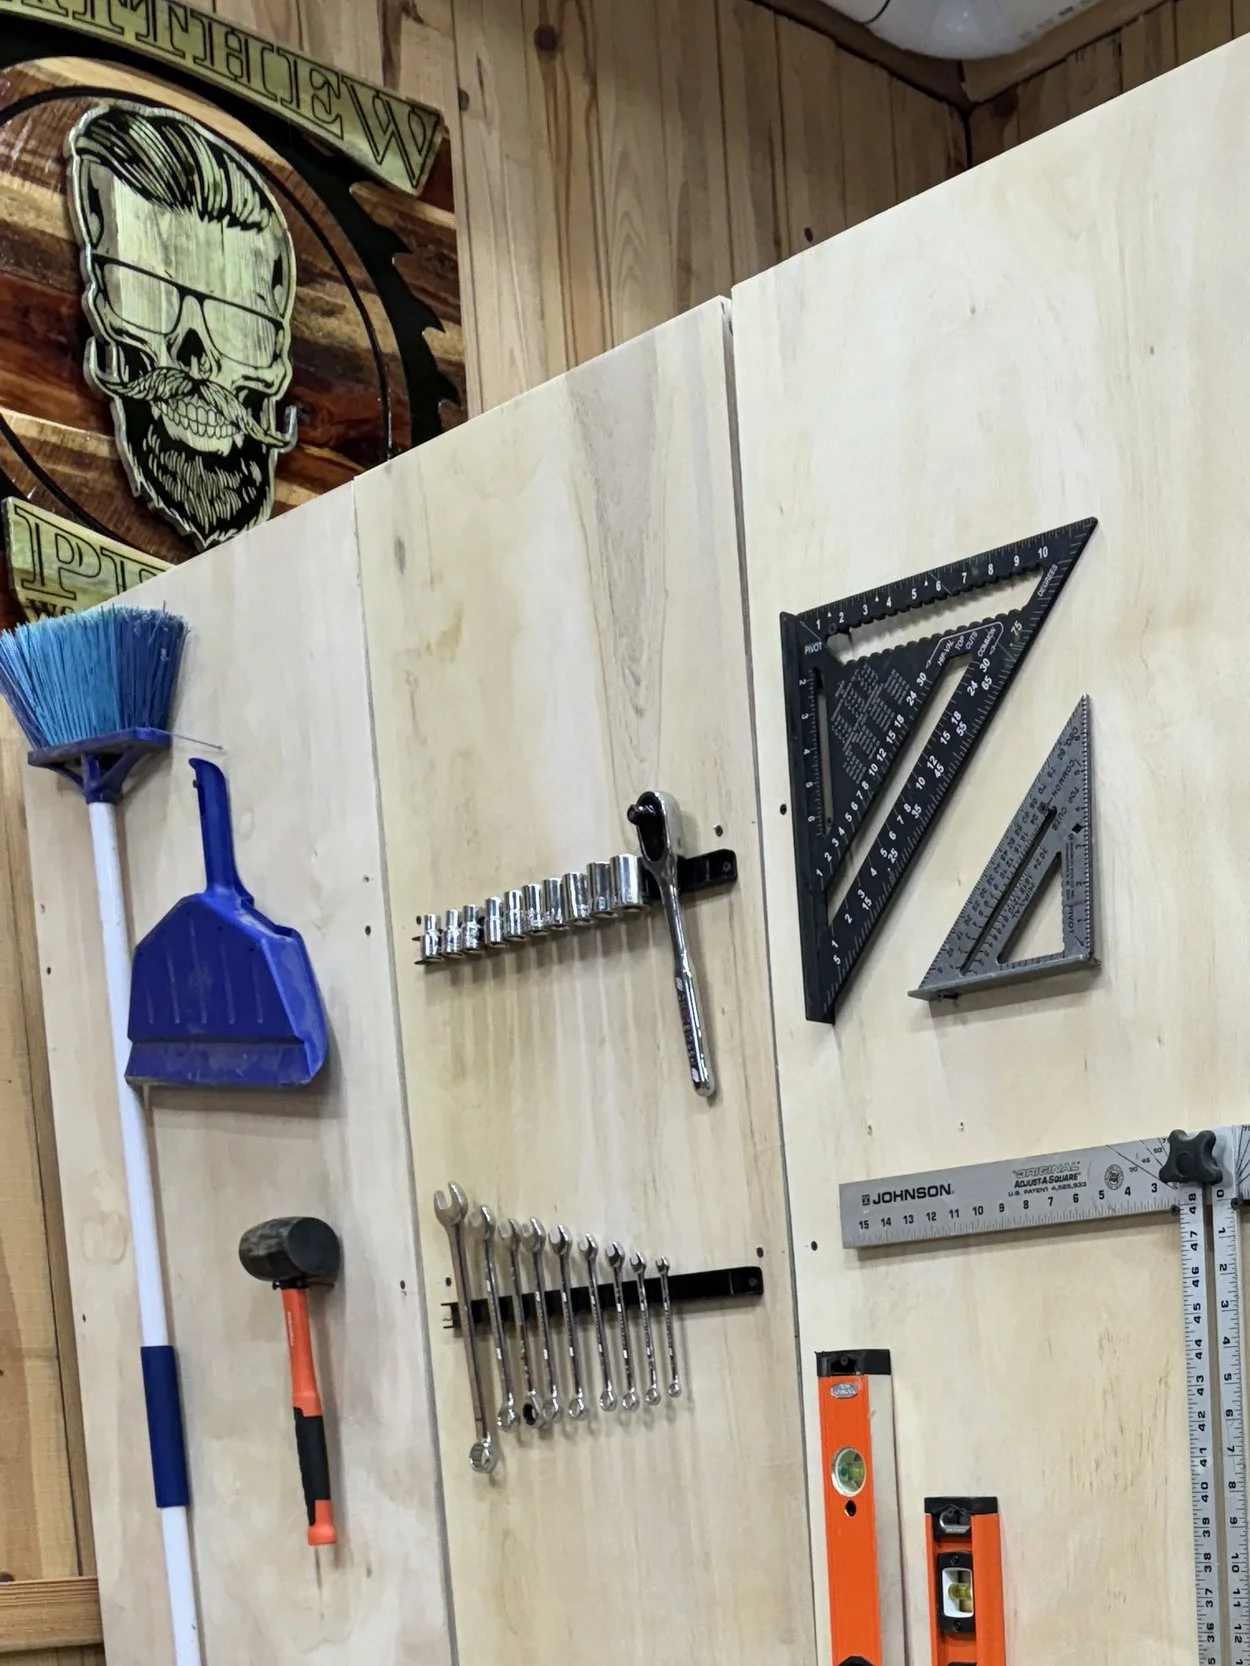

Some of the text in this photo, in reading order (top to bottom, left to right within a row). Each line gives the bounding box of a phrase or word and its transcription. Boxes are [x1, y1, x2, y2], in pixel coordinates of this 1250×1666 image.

[816, 546, 1049, 631] 1 2 3 4 5 6 7 8 9 10
[1036, 563, 1059, 598] DEGREES
[803, 640, 823, 656] PIVOT
[954, 634, 965, 652] TOP
[977, 626, 998, 658] COMMON
[816, 672, 928, 877] 30 24 18 15 12 10 8 7 6 5 4 3 2 1
[831, 657, 991, 949] 30 24 18 15 12 10 8 7 6 5 4 3 2 1
[832, 620, 1024, 966] 75 65 55 45 35 25 15 5
[1067, 905, 1075, 935] PIVOT
[858, 1182, 1158, 1231] 15 14 13 12 11 10 9 8 7 6 5 4 3
[872, 1183, 951, 1205] JOHNSON
